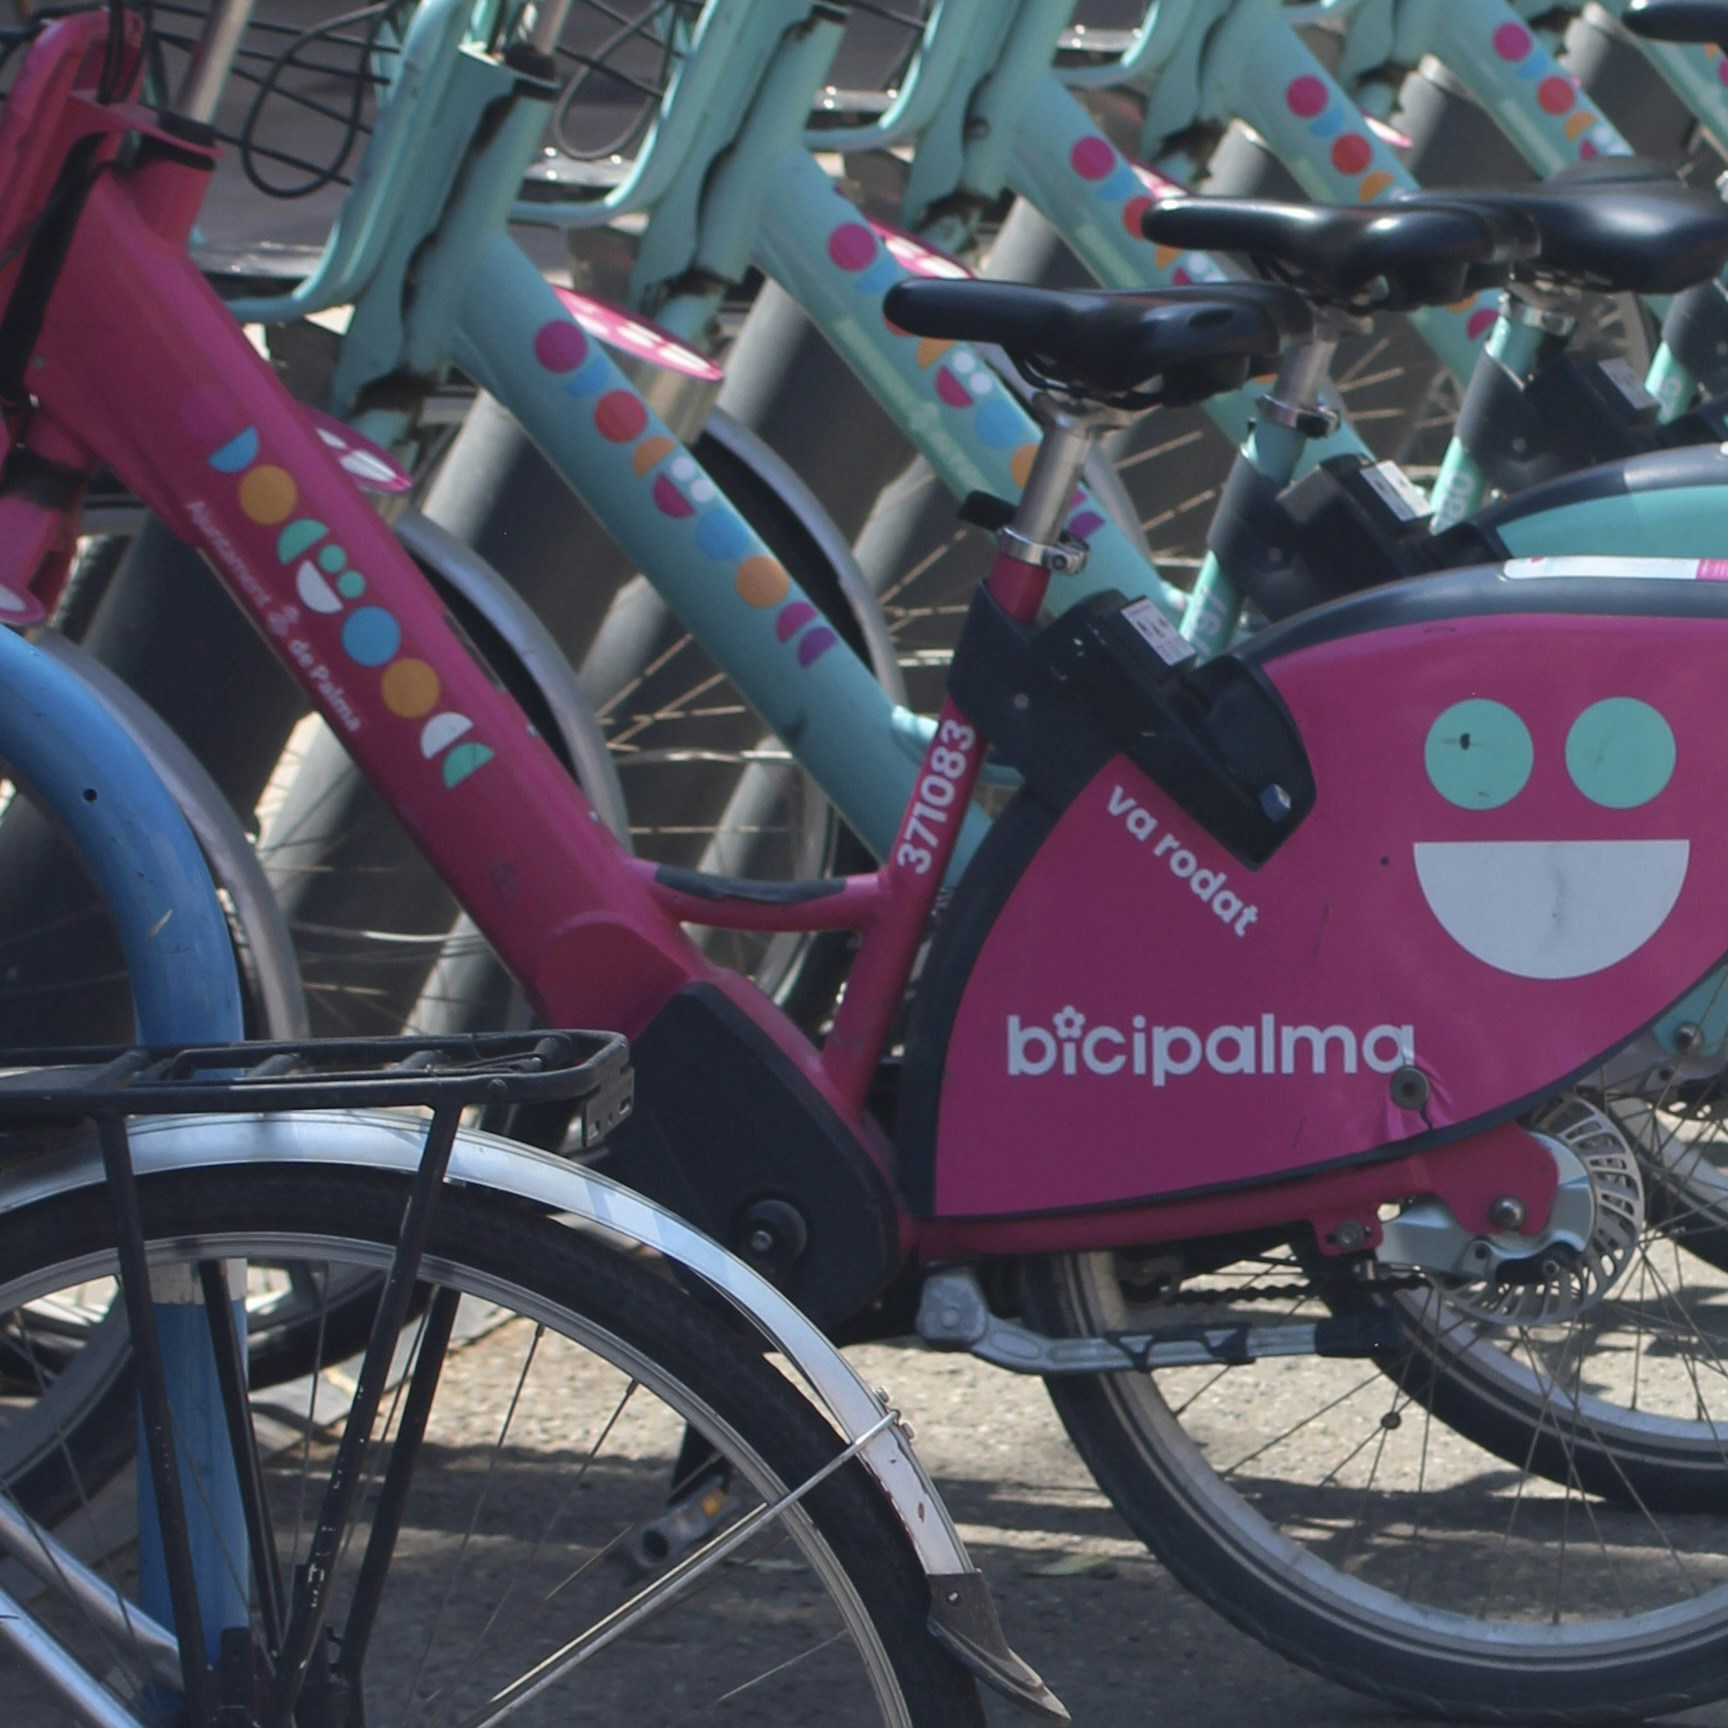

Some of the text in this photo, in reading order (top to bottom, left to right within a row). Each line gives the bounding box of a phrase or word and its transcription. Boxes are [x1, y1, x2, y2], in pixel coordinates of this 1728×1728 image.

[310, 664, 360, 732] Palma
[896, 719, 976, 875] 371083
[1106, 785, 1259, 938] va rodat
[1007, 1005, 1414, 1087] bicipalma
